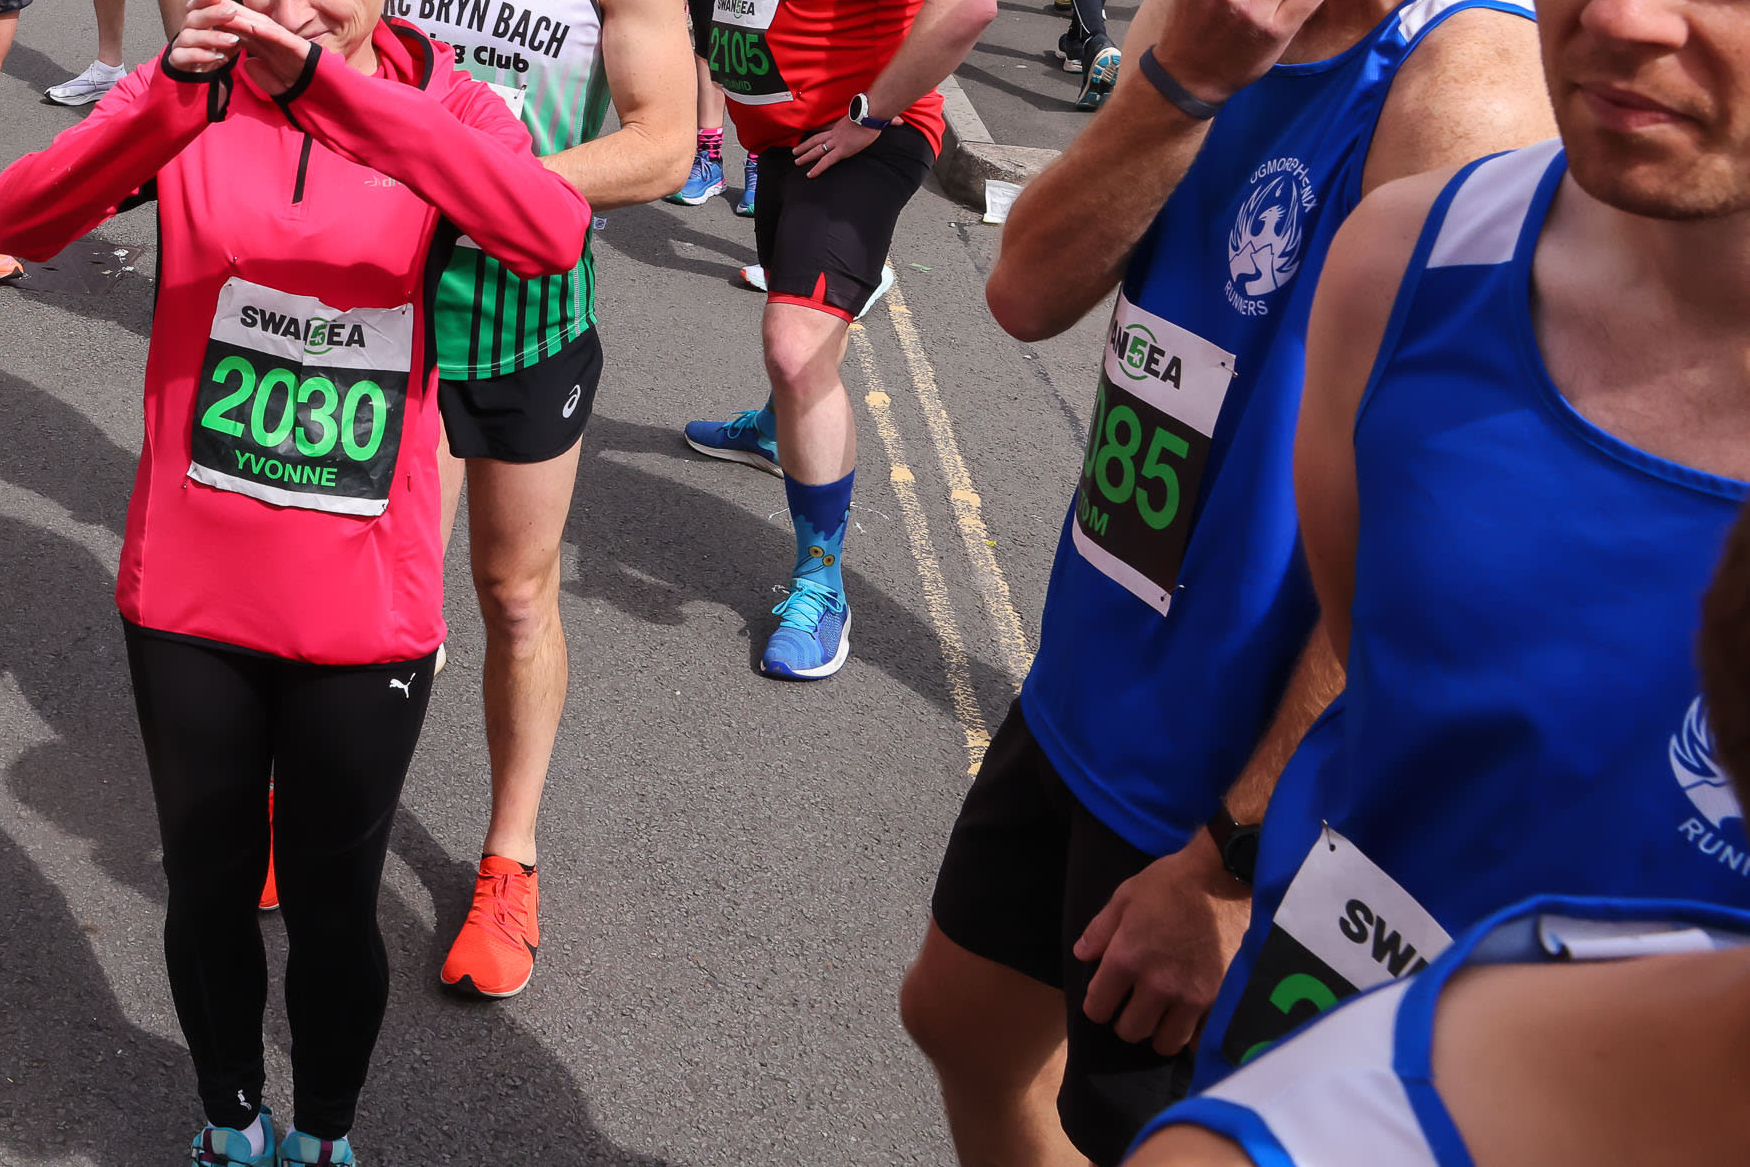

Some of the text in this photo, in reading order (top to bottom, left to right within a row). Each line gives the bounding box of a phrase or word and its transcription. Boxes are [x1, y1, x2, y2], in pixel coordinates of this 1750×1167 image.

[492, 1, 570, 59] BACH
[710, 26, 770, 76] 2105
[473, 44, 530, 73] Club
[1224, 281, 1268, 316] RUNNERS
[201, 355, 388, 462] 2030
[235, 449, 338, 487] YVONNE
